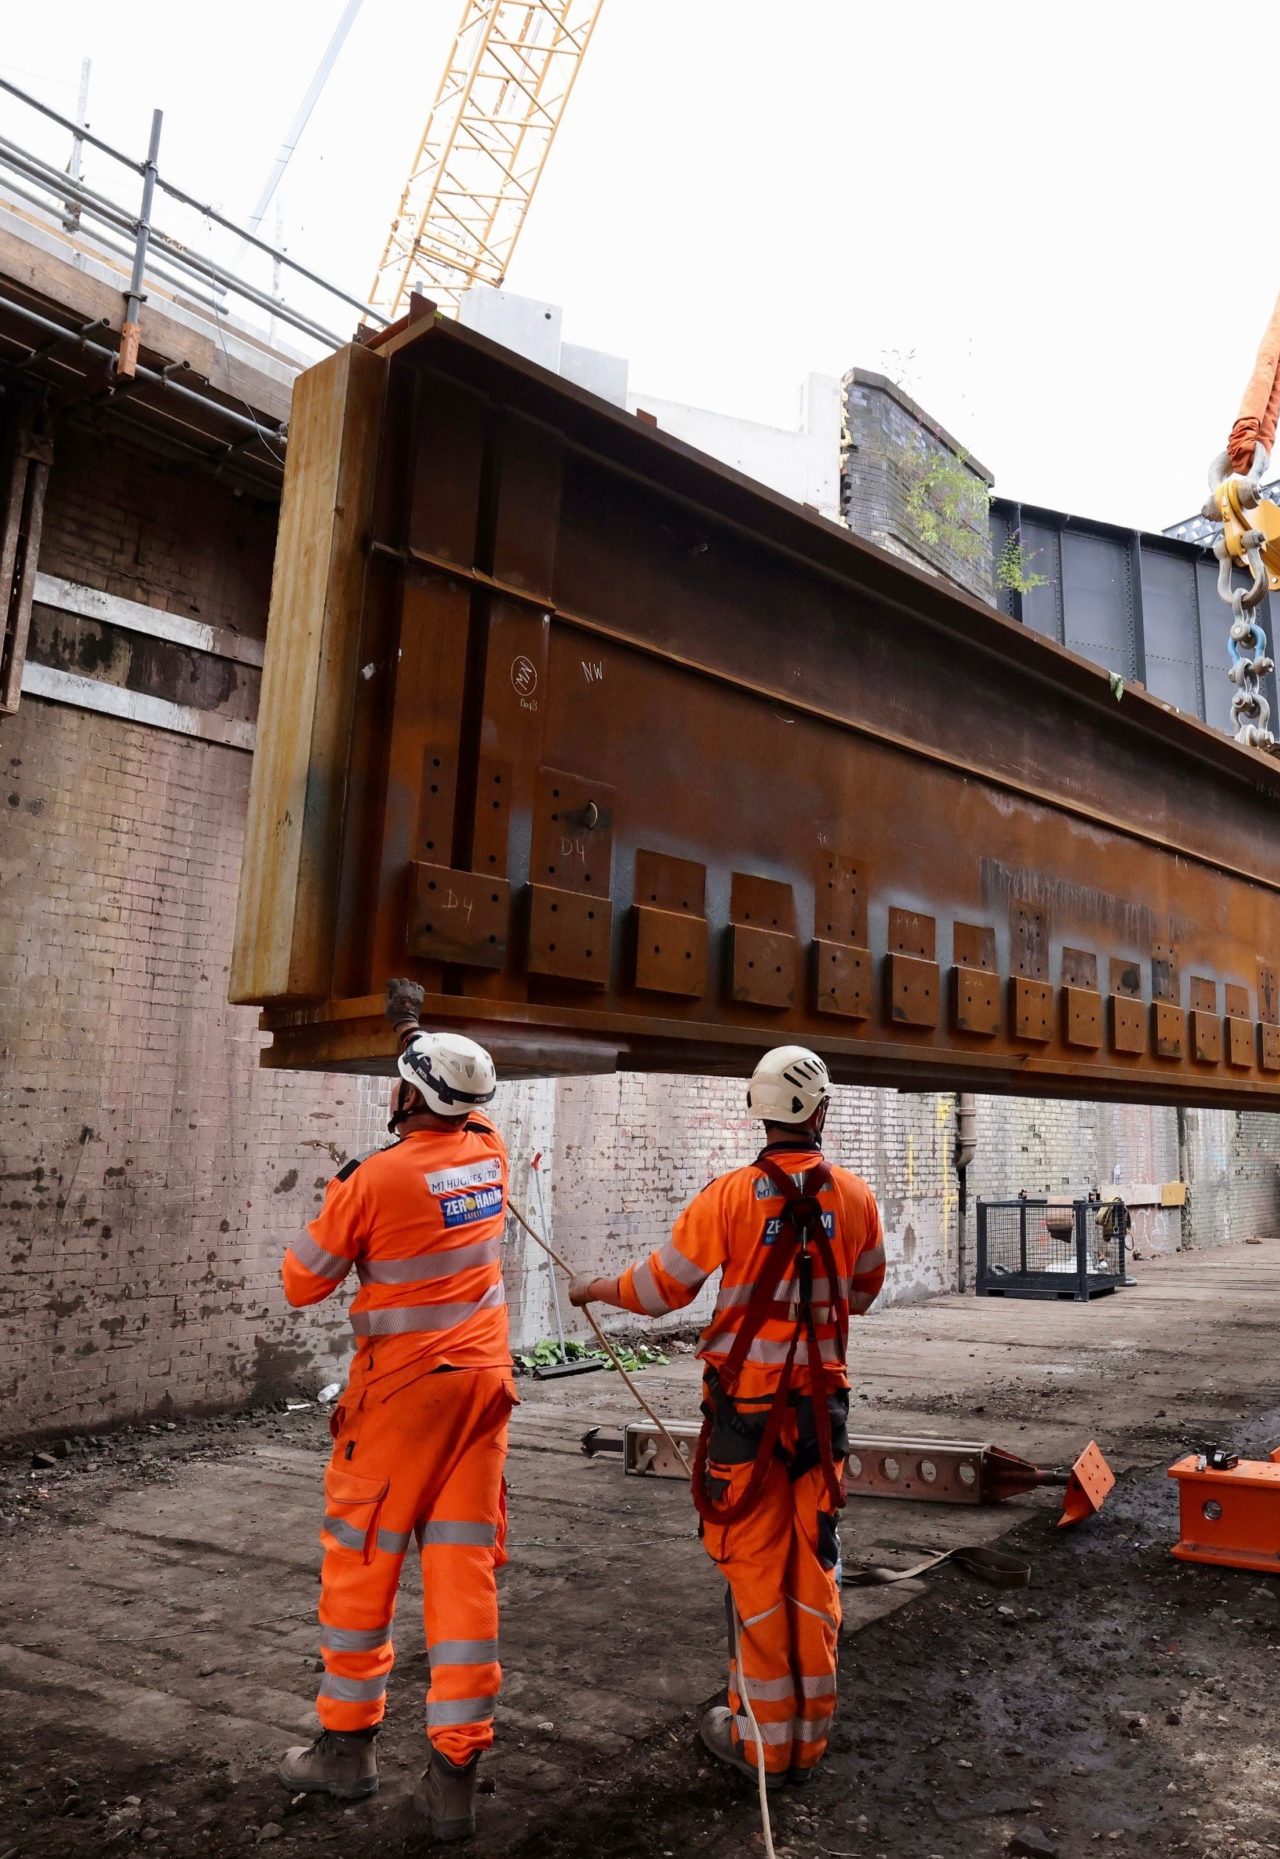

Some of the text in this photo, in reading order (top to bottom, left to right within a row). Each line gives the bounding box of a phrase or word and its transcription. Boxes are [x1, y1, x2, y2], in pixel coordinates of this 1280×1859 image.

[581, 661, 603, 683] NW
[561, 838, 585, 864] D4
[441, 889, 473, 924] D4
[474, 1189, 502, 1208] HARM
